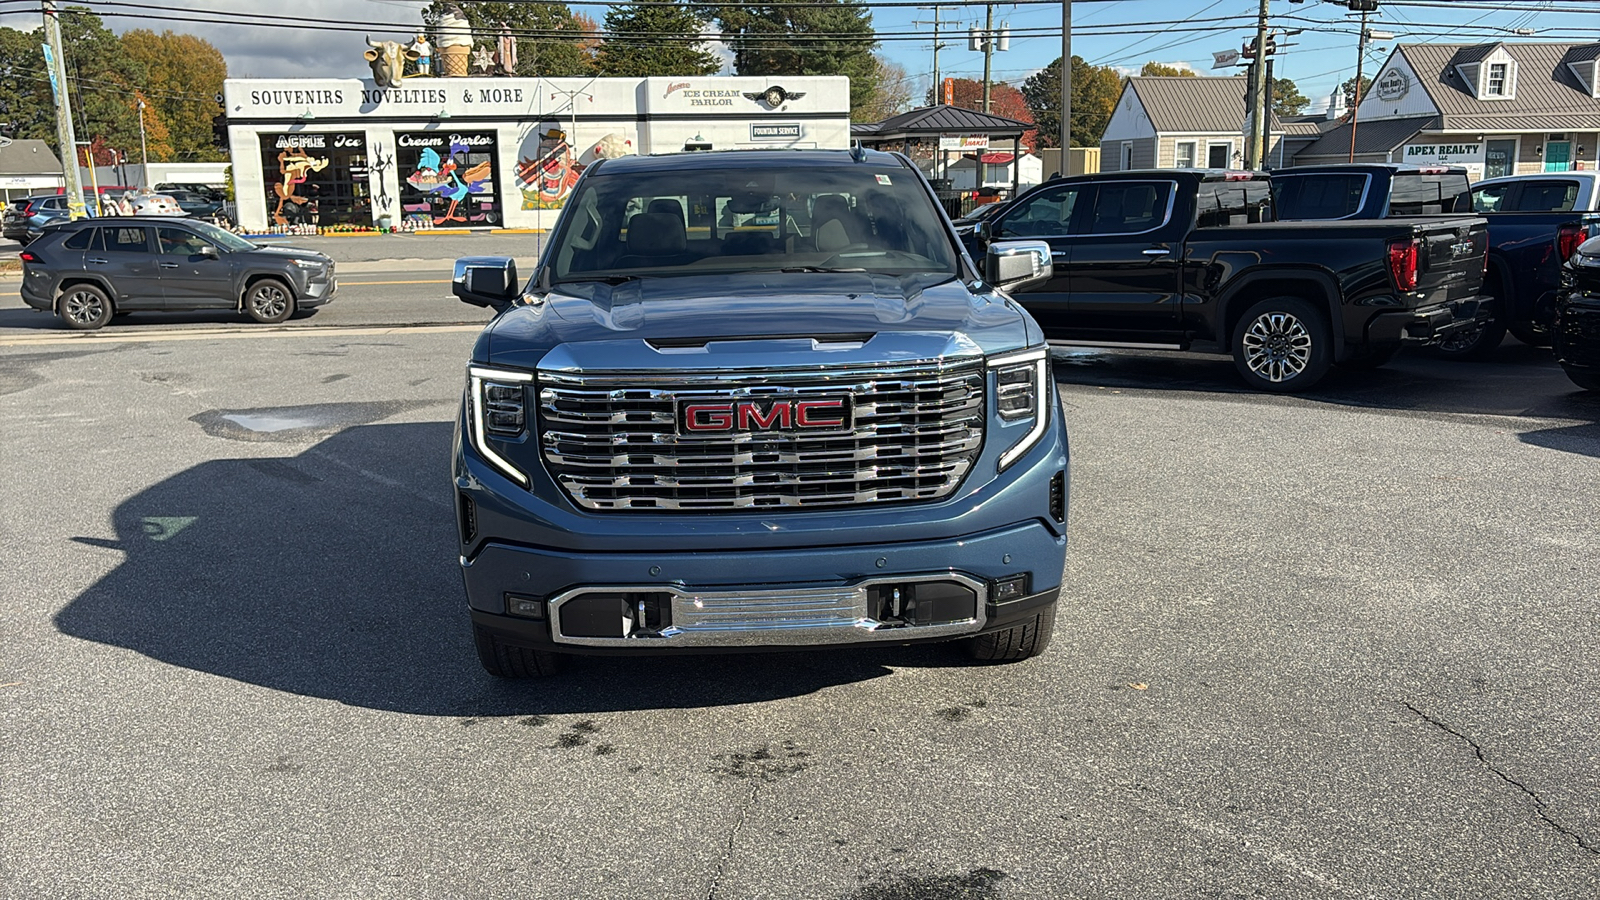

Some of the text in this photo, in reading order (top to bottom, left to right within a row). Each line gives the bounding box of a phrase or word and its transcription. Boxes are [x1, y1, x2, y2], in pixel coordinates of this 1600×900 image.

[251, 88, 523, 105] SOUVENIRS NOVELTIES & MORE
[683, 90, 740, 98] ICE CREAM
[690, 98, 733, 106] PARLOR
[753, 127, 798, 135] FOUNTAIN SERVICE
[275, 134, 363, 148] ACME Ice
[398, 133, 494, 147] Cream Parlor
[1407, 145, 1436, 156] APEX
[1438, 144, 1480, 155] REALTY
[685, 399, 844, 432] GMC
